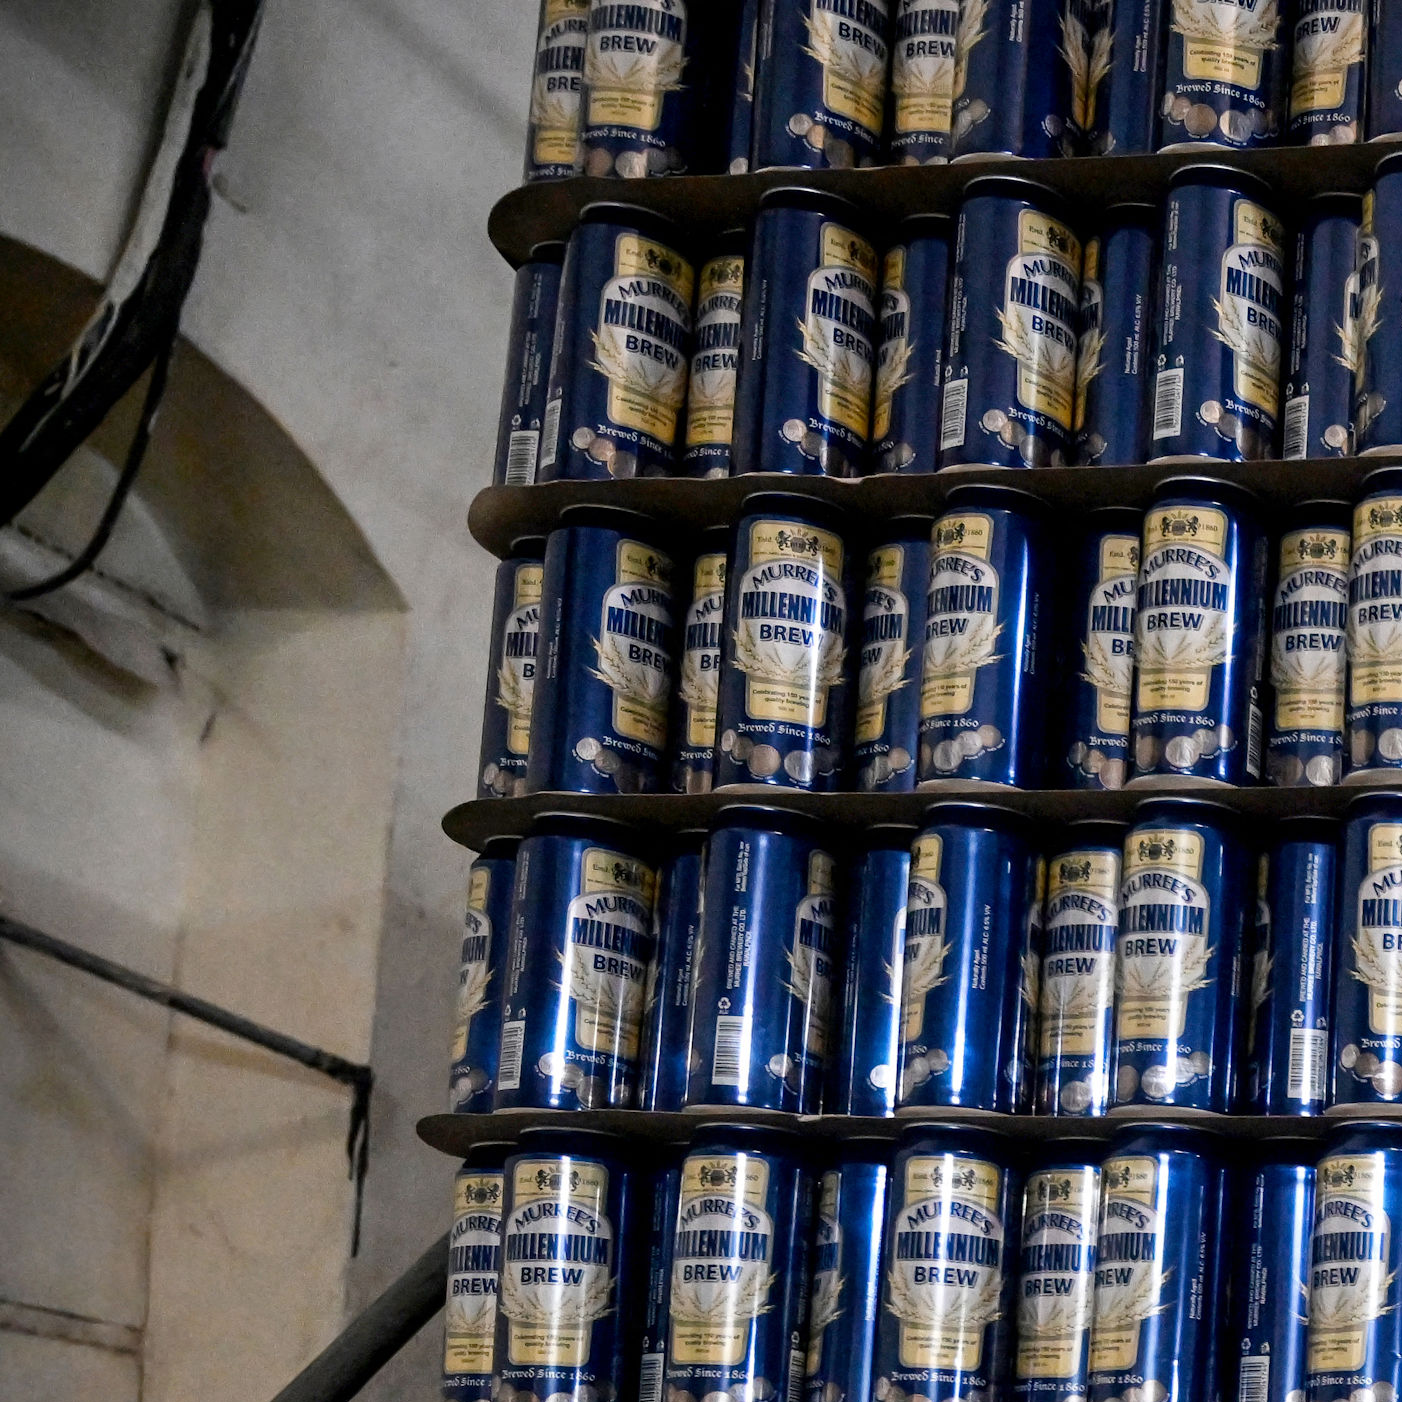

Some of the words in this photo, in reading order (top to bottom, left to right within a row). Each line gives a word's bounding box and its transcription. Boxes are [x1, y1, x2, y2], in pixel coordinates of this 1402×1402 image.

[1176, 83, 1211, 95] Brewed
[1214, 87, 1240, 101] Since
[1243, 92, 1265, 108] 1860
[1147, 613, 1204, 631] BREW
[738, 722, 776, 736] Brewed
[778, 725, 805, 739] Since
[1361, 1038, 1400, 1053] Brewed
[514, 1203, 601, 1235] MURREE'S
[507, 1233, 608, 1264] MILLENNIUM
[520, 1265, 584, 1285] BREW
[913, 1266, 979, 1287] BREW
[501, 1369, 534, 1383] Brewed
[537, 1369, 566, 1381] Since
[569, 1371, 595, 1383] 1860
[891, 1369, 929, 1384] Brewed
[962, 1376, 986, 1387] 1860
